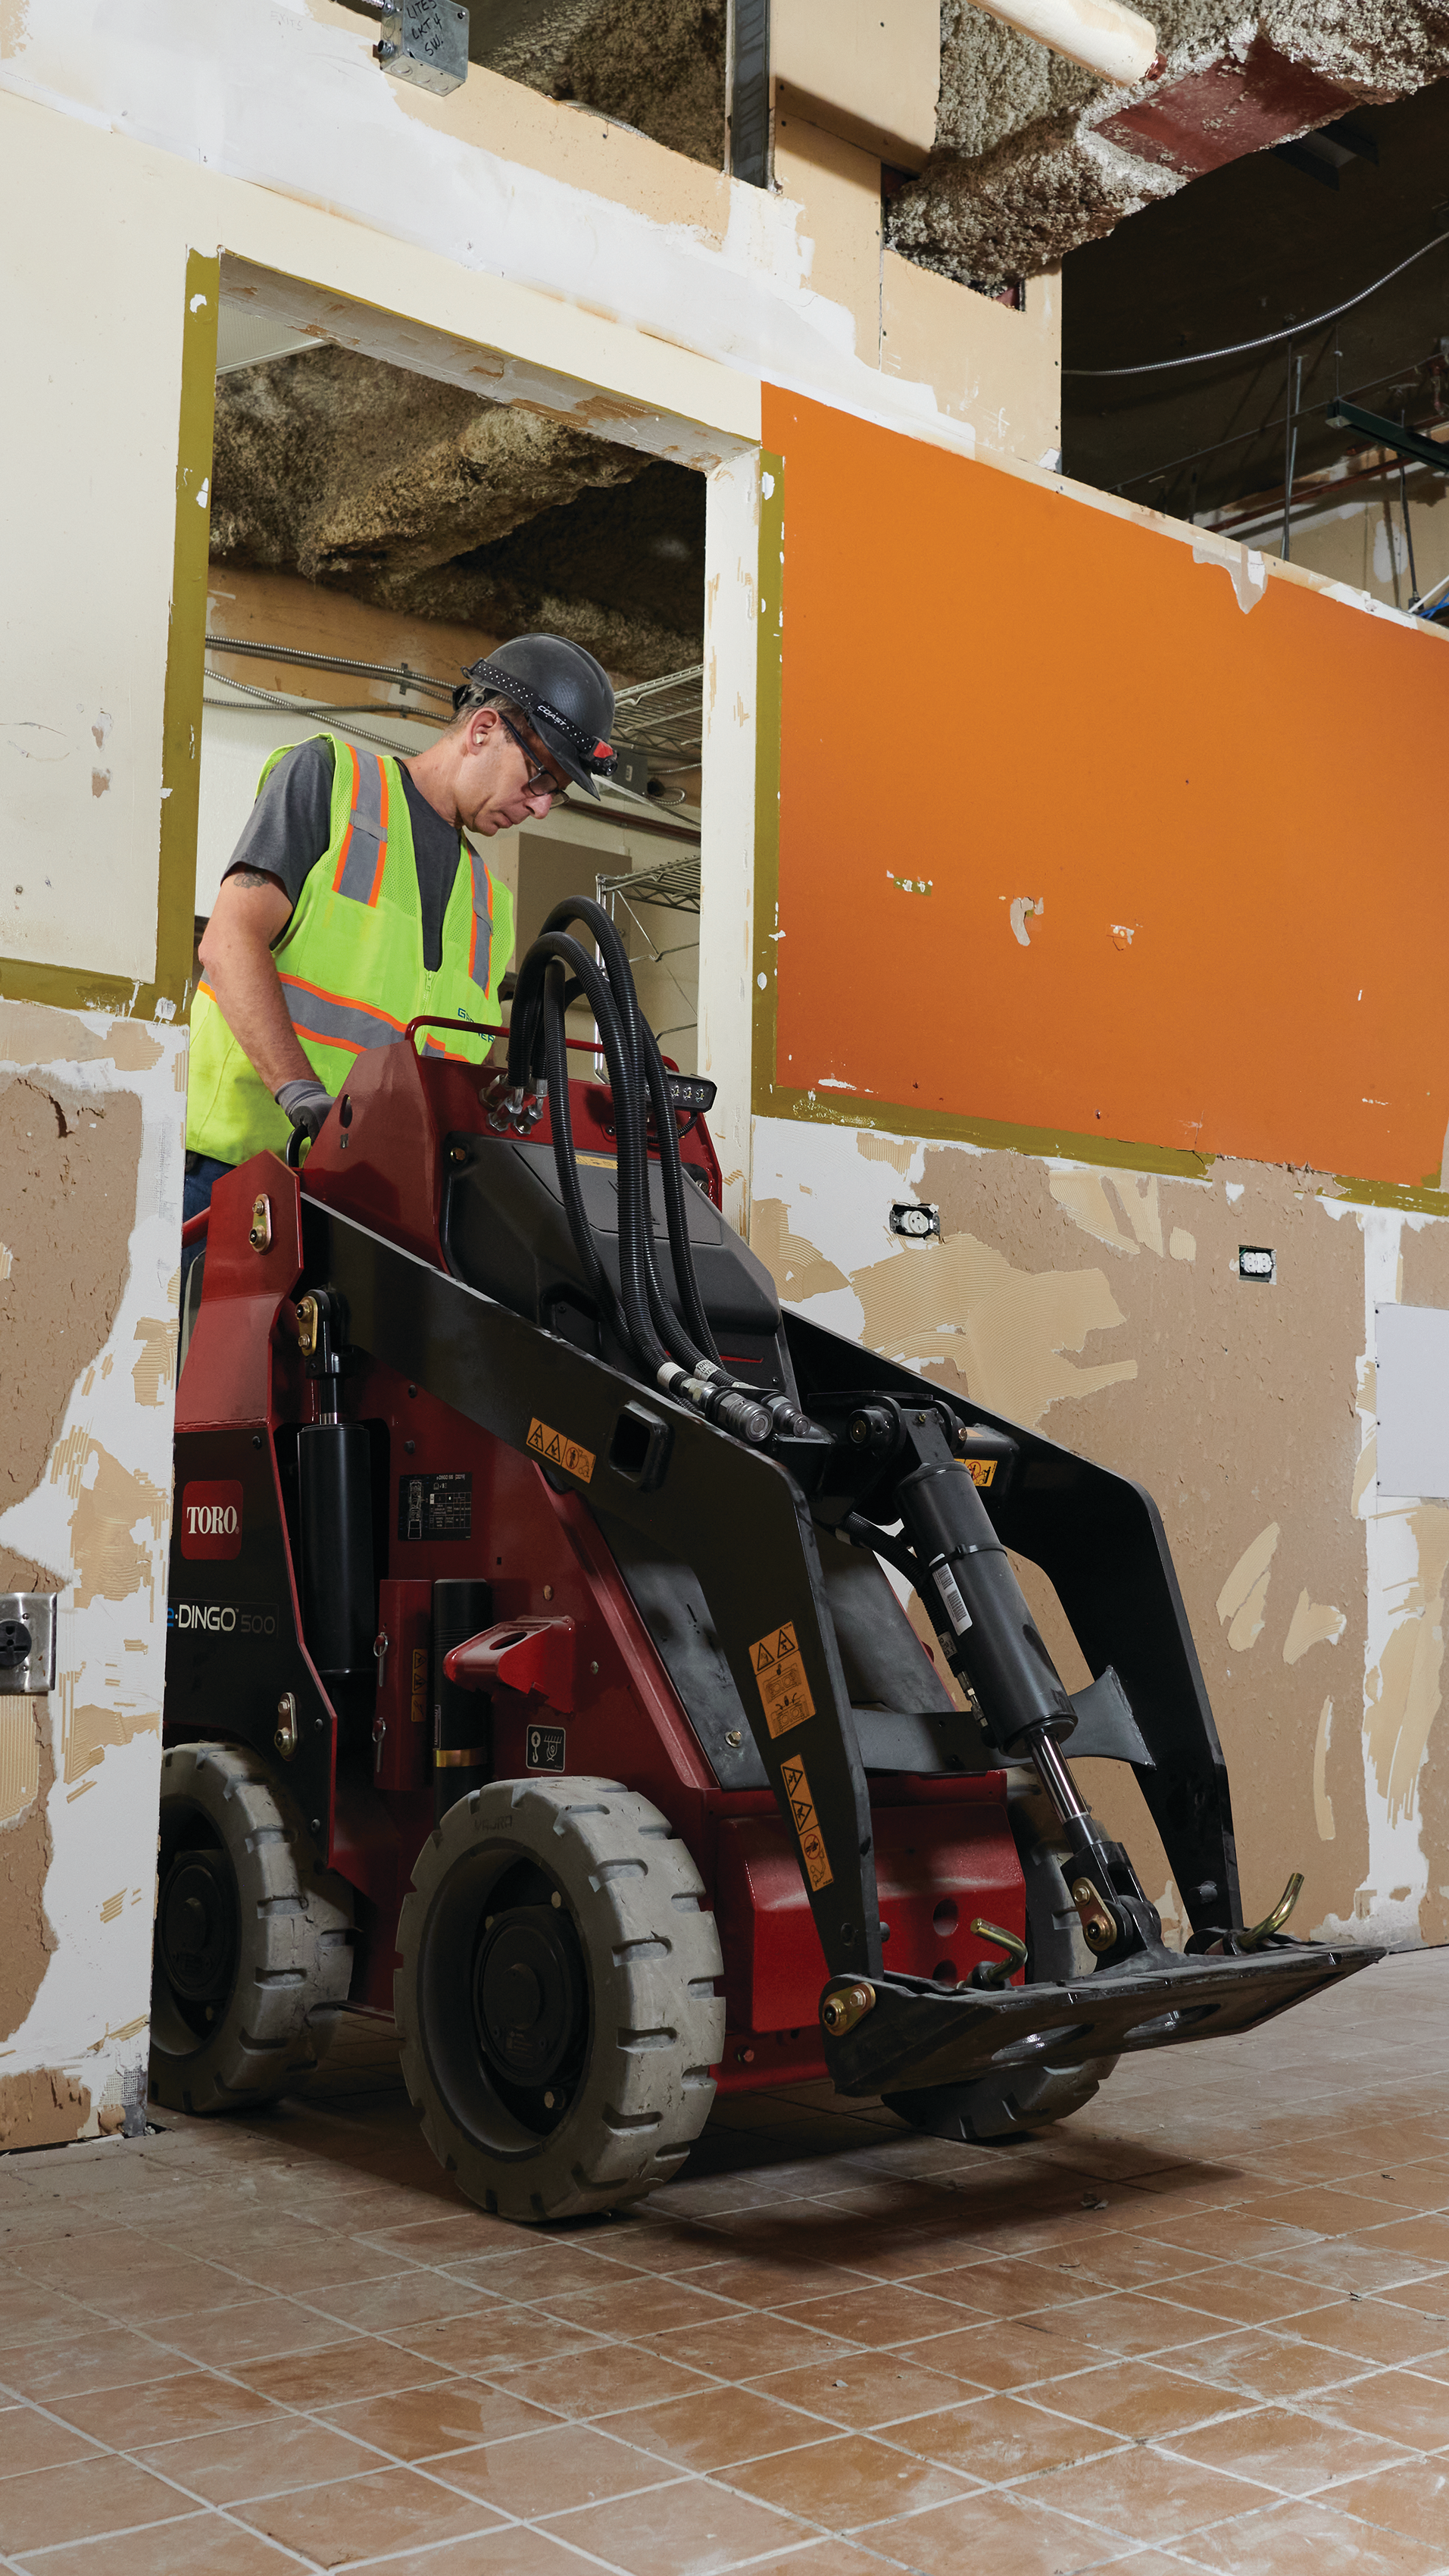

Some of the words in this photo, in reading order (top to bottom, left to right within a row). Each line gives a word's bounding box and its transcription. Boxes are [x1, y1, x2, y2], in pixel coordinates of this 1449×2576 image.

[411, 17, 431, 39] CKT
[433, 13, 442, 30] 4
[537, 705, 567, 726] COAST
[186, 1505, 238, 1534] TORO
[240, 1614, 276, 1634] 500
